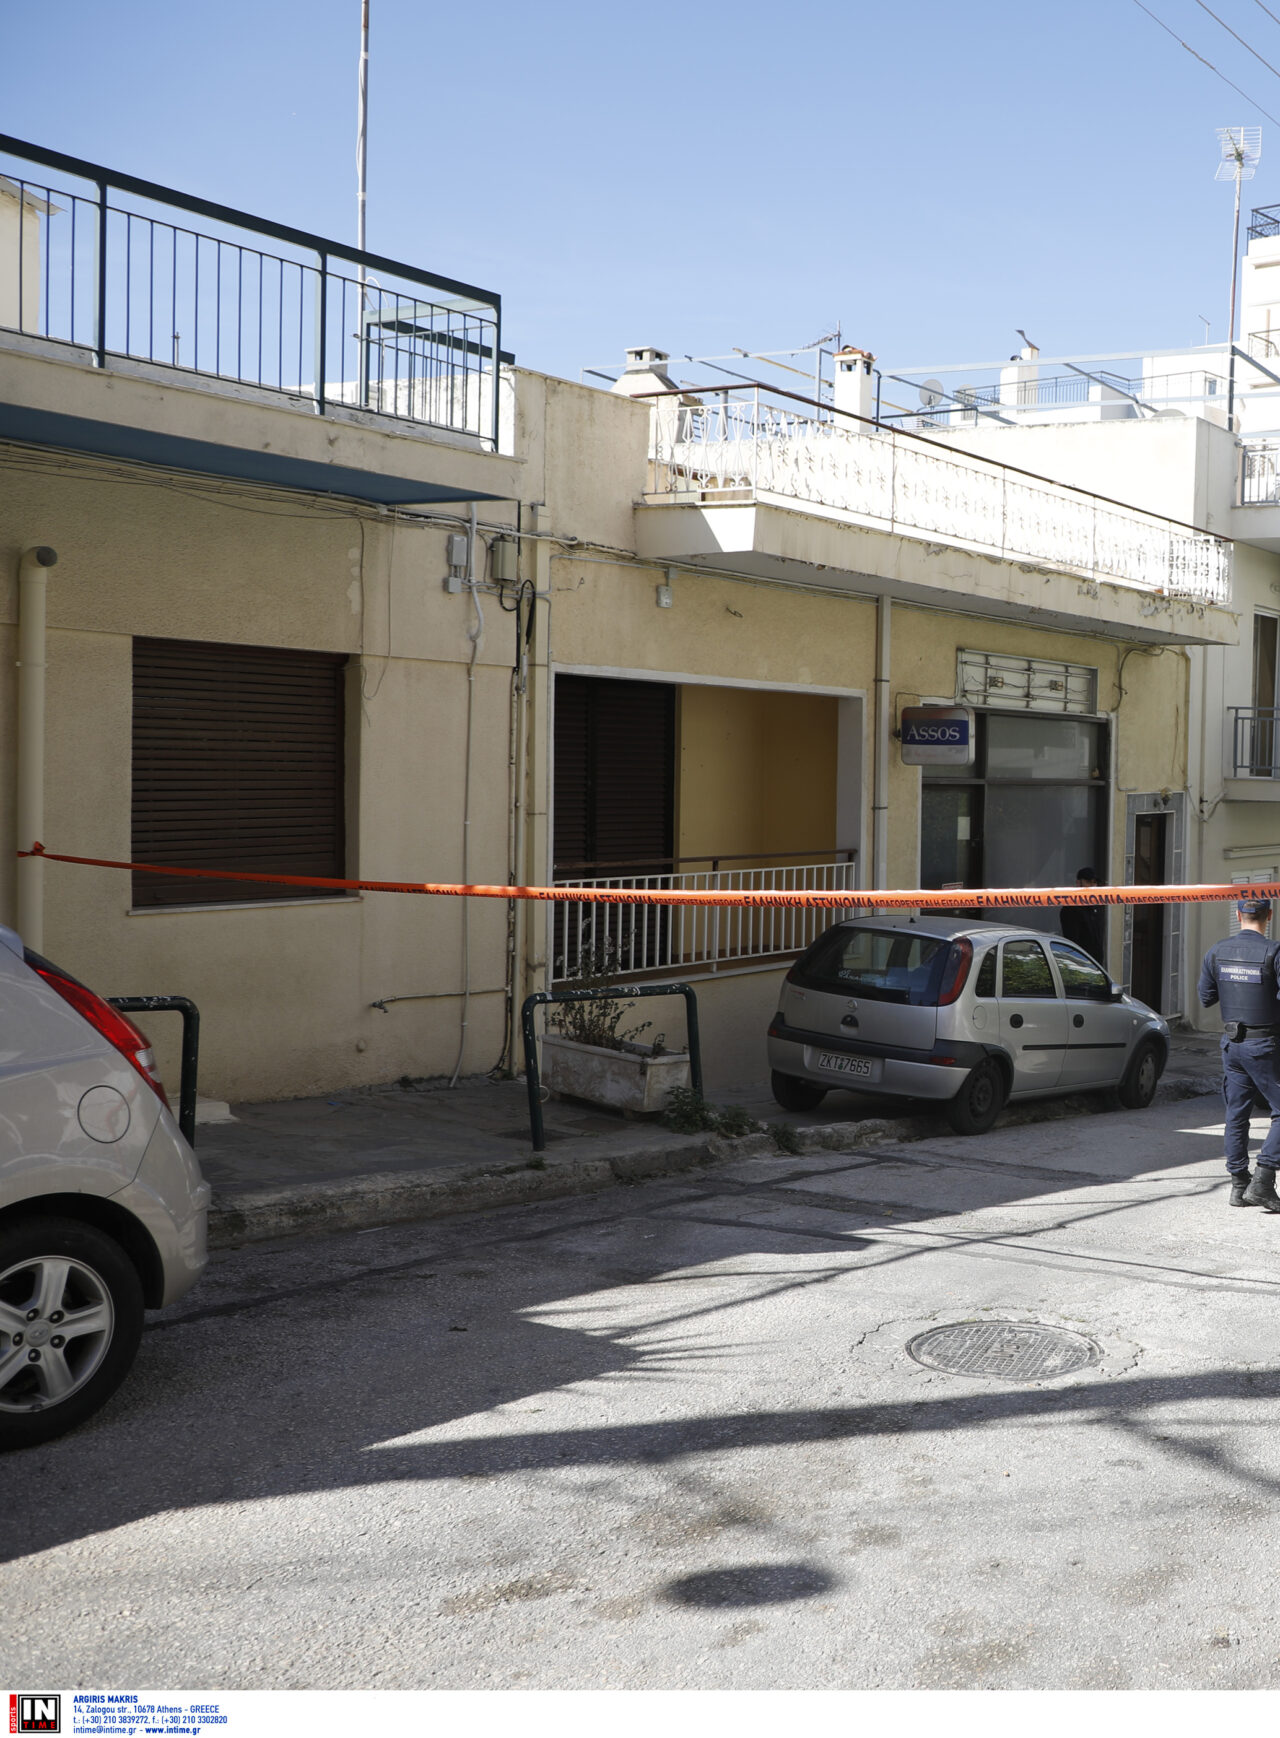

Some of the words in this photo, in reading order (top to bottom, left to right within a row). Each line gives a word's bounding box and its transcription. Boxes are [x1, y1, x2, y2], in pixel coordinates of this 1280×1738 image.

[907, 725, 960, 740] ASSOS
[976, 895, 1043, 906] ΕΛΛΗΝΙΚΗ
[1046, 894, 1124, 906] ΑΣΤΥΝΟΜΙΑ
